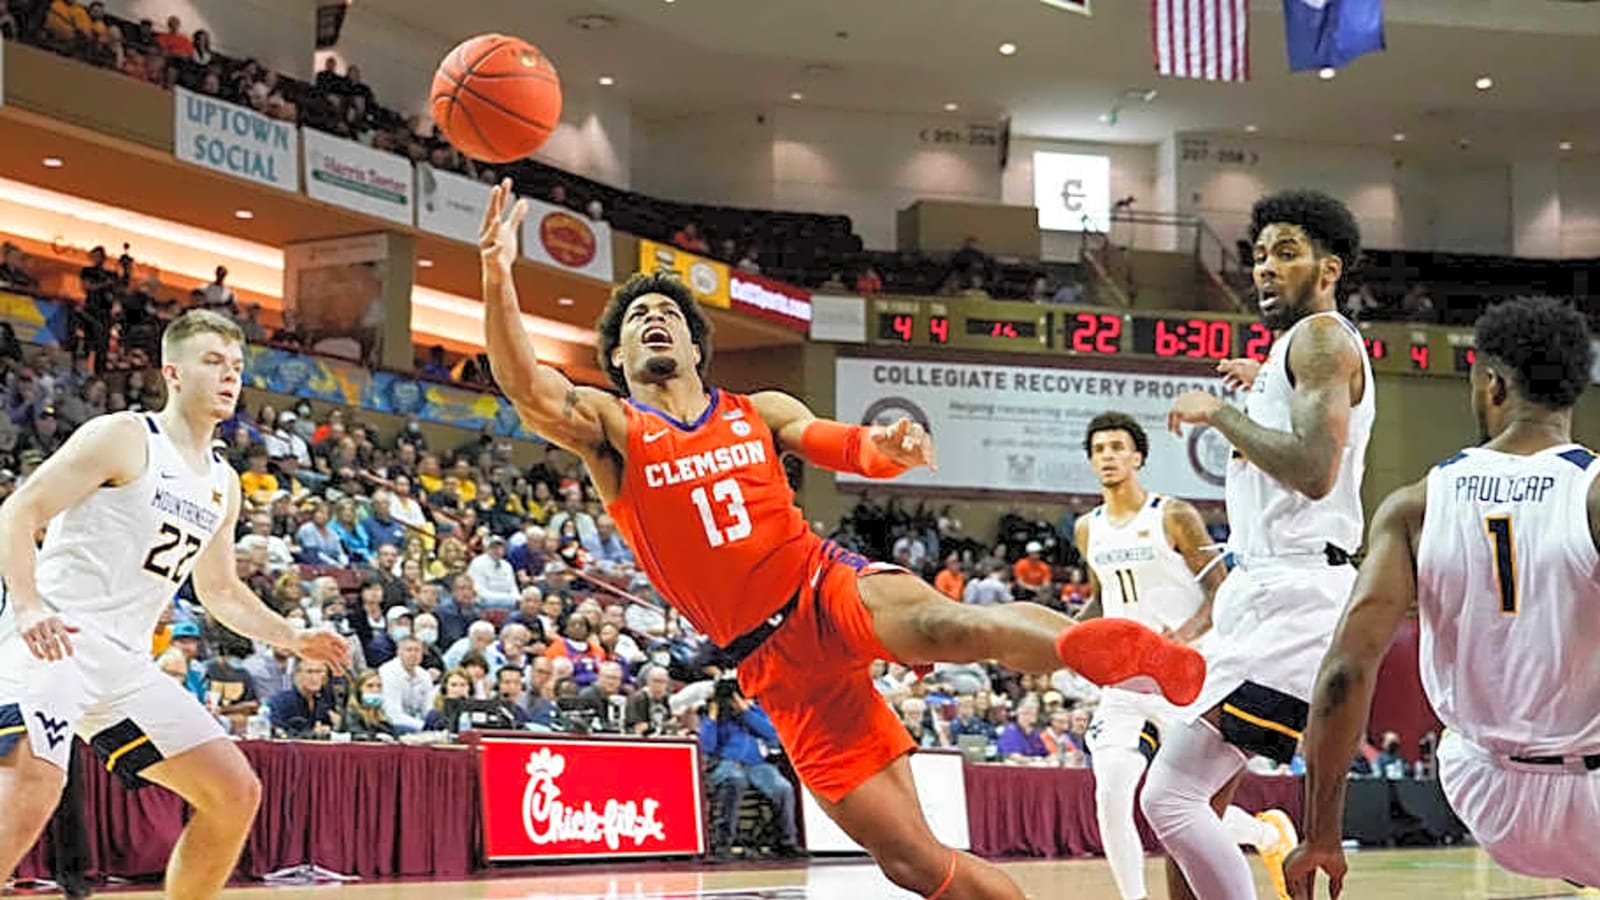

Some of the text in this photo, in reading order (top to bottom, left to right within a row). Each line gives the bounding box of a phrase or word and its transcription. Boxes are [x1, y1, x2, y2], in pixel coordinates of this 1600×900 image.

[186, 96, 289, 151] UPTOWN
[194, 134, 279, 182] SOCIAL
[893, 314, 912, 341] 4
[930, 316, 948, 342] 4
[1072, 313, 1122, 353] 22
[1155, 319, 1232, 359] 6:30
[1246, 323, 1275, 361] 2
[1410, 345, 1428, 370] 4
[873, 365, 1007, 389] COLLEGIATE
[1014, 374, 1125, 397] RECOVERY
[645, 440, 766, 488] CLEMSON
[691, 478, 752, 548] 13
[142, 521, 202, 584] 22
[1485, 512, 1519, 616] 1
[1115, 568, 1138, 604] 11
